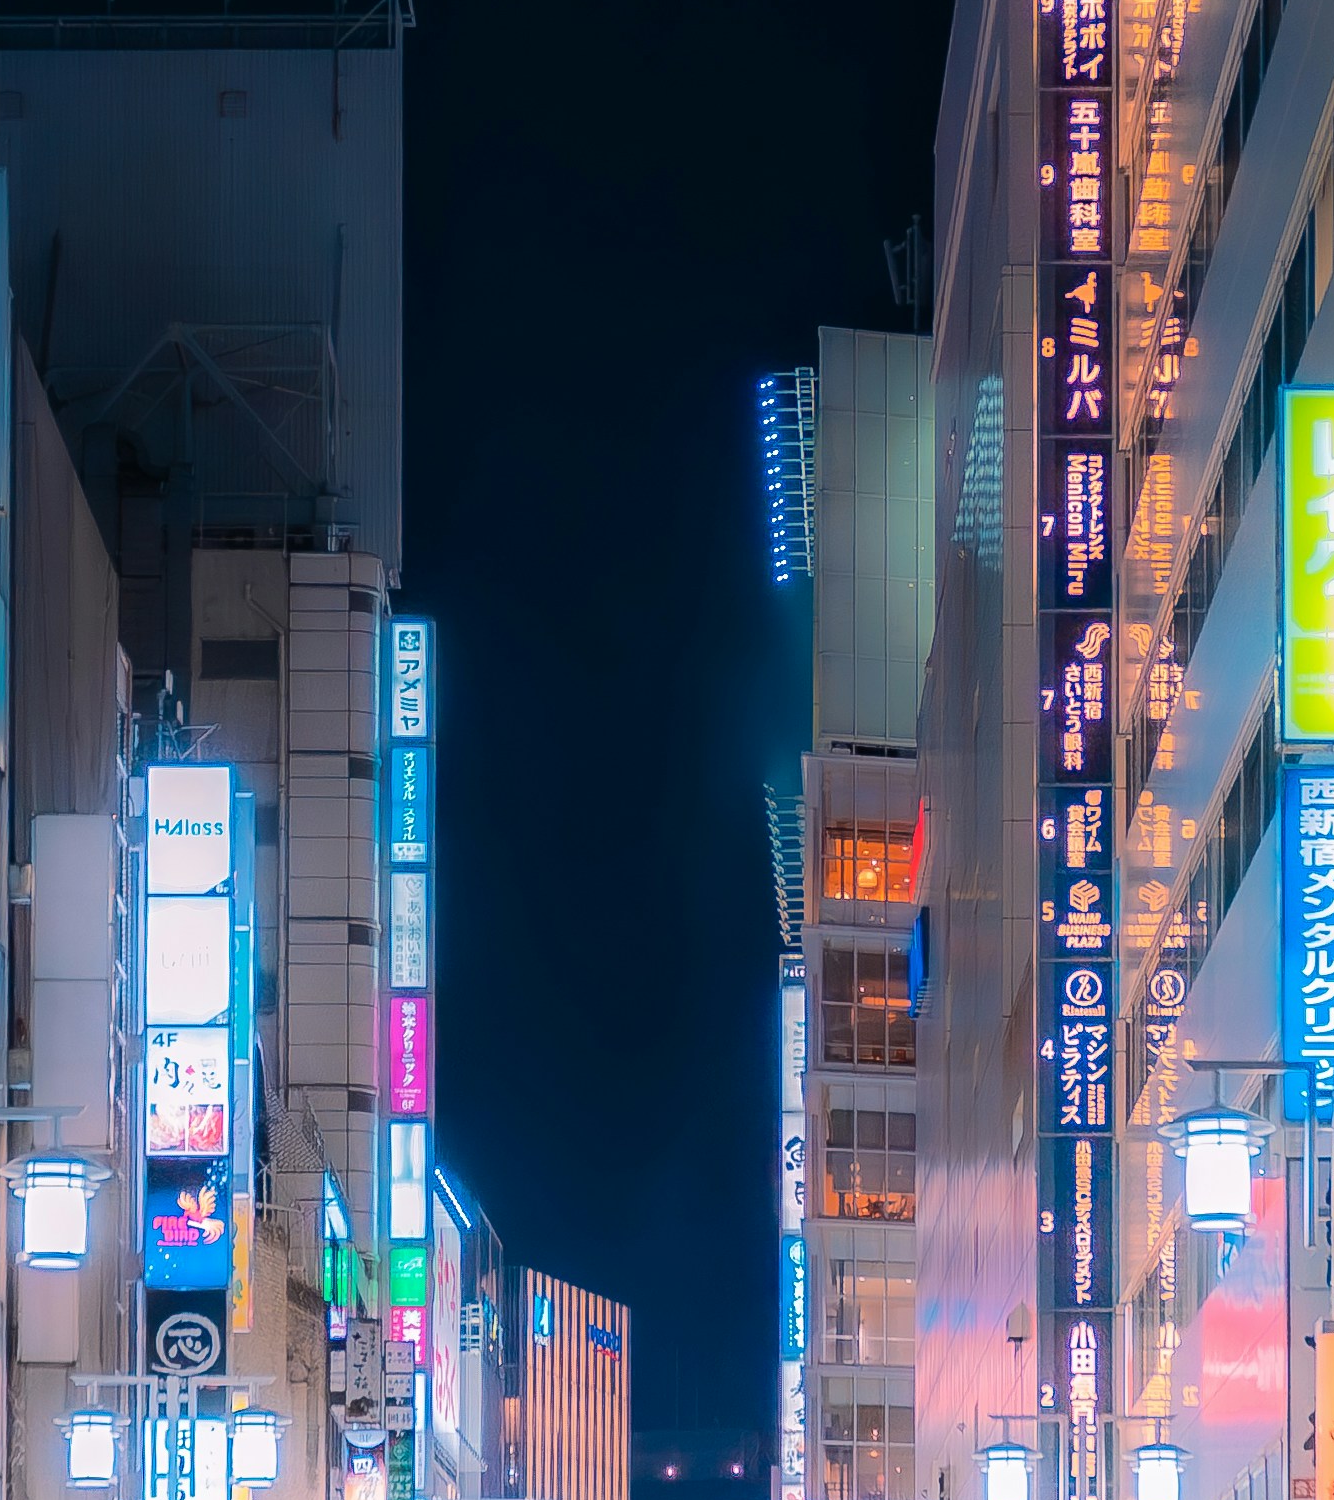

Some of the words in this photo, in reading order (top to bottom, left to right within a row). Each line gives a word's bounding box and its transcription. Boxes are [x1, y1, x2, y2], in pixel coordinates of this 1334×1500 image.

[1041, 165, 1055, 186] 9
[1070, 102, 1100, 252] 五十嵐歯科室
[1042, 338, 1055, 358] 8
[1067, 454, 1087, 537] Menicon
[1042, 515, 1055, 537] 7
[1067, 543, 1086, 596] Miru
[399, 659, 421, 731] アメミヤ
[1042, 690, 1054, 711] 7
[1083, 663, 1103, 721] 西新宿
[1042, 819, 1055, 841] 6
[1042, 901, 1054, 921] 5
[1066, 936, 1102, 949] PLAZA
[152, 1032, 178, 1048] 4F
[1040, 1040, 1055, 1060] 4
[1085, 1025, 1108, 1082] マシン
[1061, 1023, 1083, 1125] ピラティス
[1041, 1211, 1055, 1234] 3
[1041, 1384, 1055, 1408] 2
